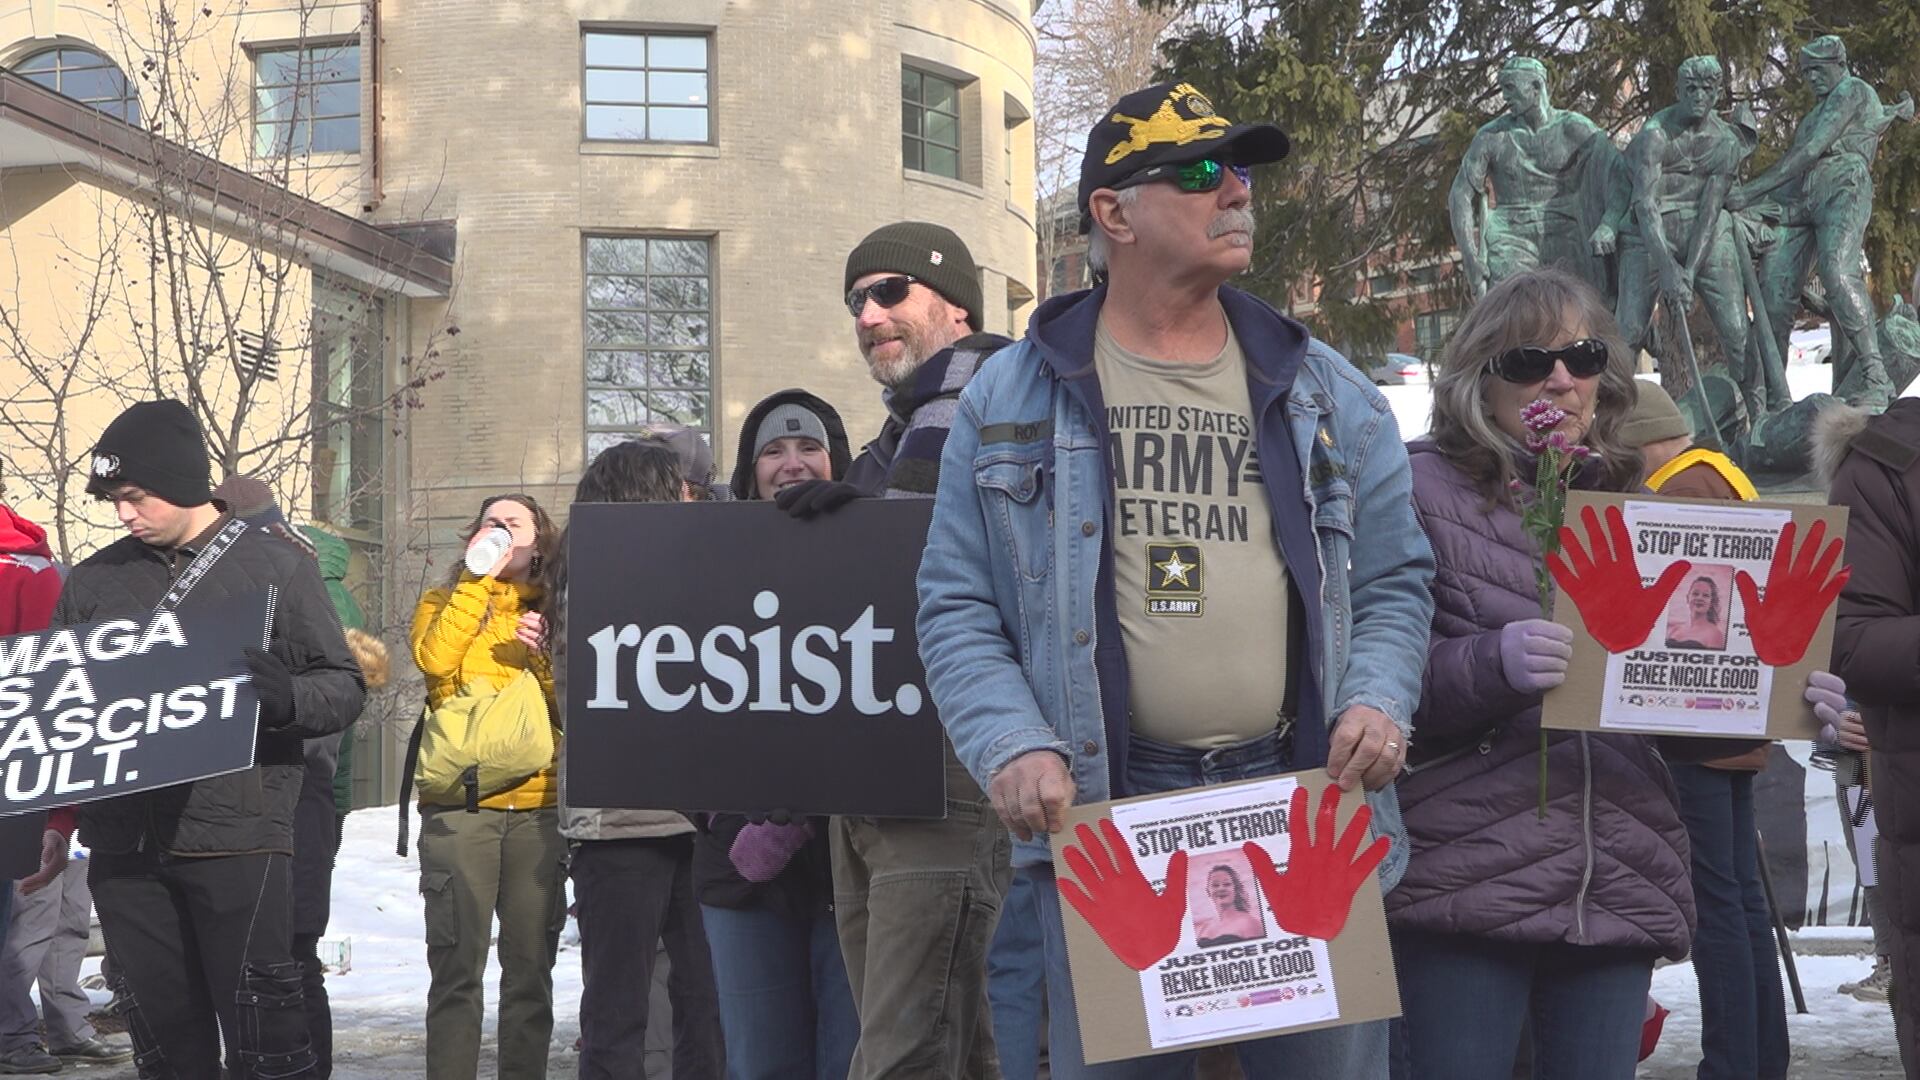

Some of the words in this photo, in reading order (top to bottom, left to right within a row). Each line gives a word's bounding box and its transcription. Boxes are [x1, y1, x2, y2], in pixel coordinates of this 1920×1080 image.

[1014, 423, 1041, 441] ROY
[1106, 405, 1171, 429] NITED
[1178, 406, 1250, 437] STATES
[1119, 498, 1249, 542] ETERAN
[1637, 530, 1682, 556] STOP
[1683, 533, 1710, 557] ICE
[1712, 534, 1774, 561] TERROR
[586, 590, 923, 716] resist.
[1625, 650, 1716, 666] JUSTICE
[1718, 655, 1760, 668] FOR
[0, 677, 34, 720] S
[42, 667, 98, 712] A
[1622, 662, 1668, 686] RENEE
[1669, 665, 1720, 689] NICOLE
[1720, 668, 1760, 690] GOOD
[0, 674, 253, 762] ASCIST
[0, 739, 139, 802] ULT.
[1130, 820, 1160, 831] FROM
[1160, 813, 1204, 826] BANGOR
[1206, 810, 1220, 818] TO
[1136, 826, 1184, 858] STOP
[1185, 820, 1217, 850] ICE
[1216, 808, 1290, 844] TERROR
[1158, 944, 1259, 971] JUSTICE
[1261, 936, 1311, 955] FOR
[1160, 965, 1212, 996] RENEE
[1212, 957, 1270, 988] NICOLE
[1269, 950, 1316, 978] GOOD
